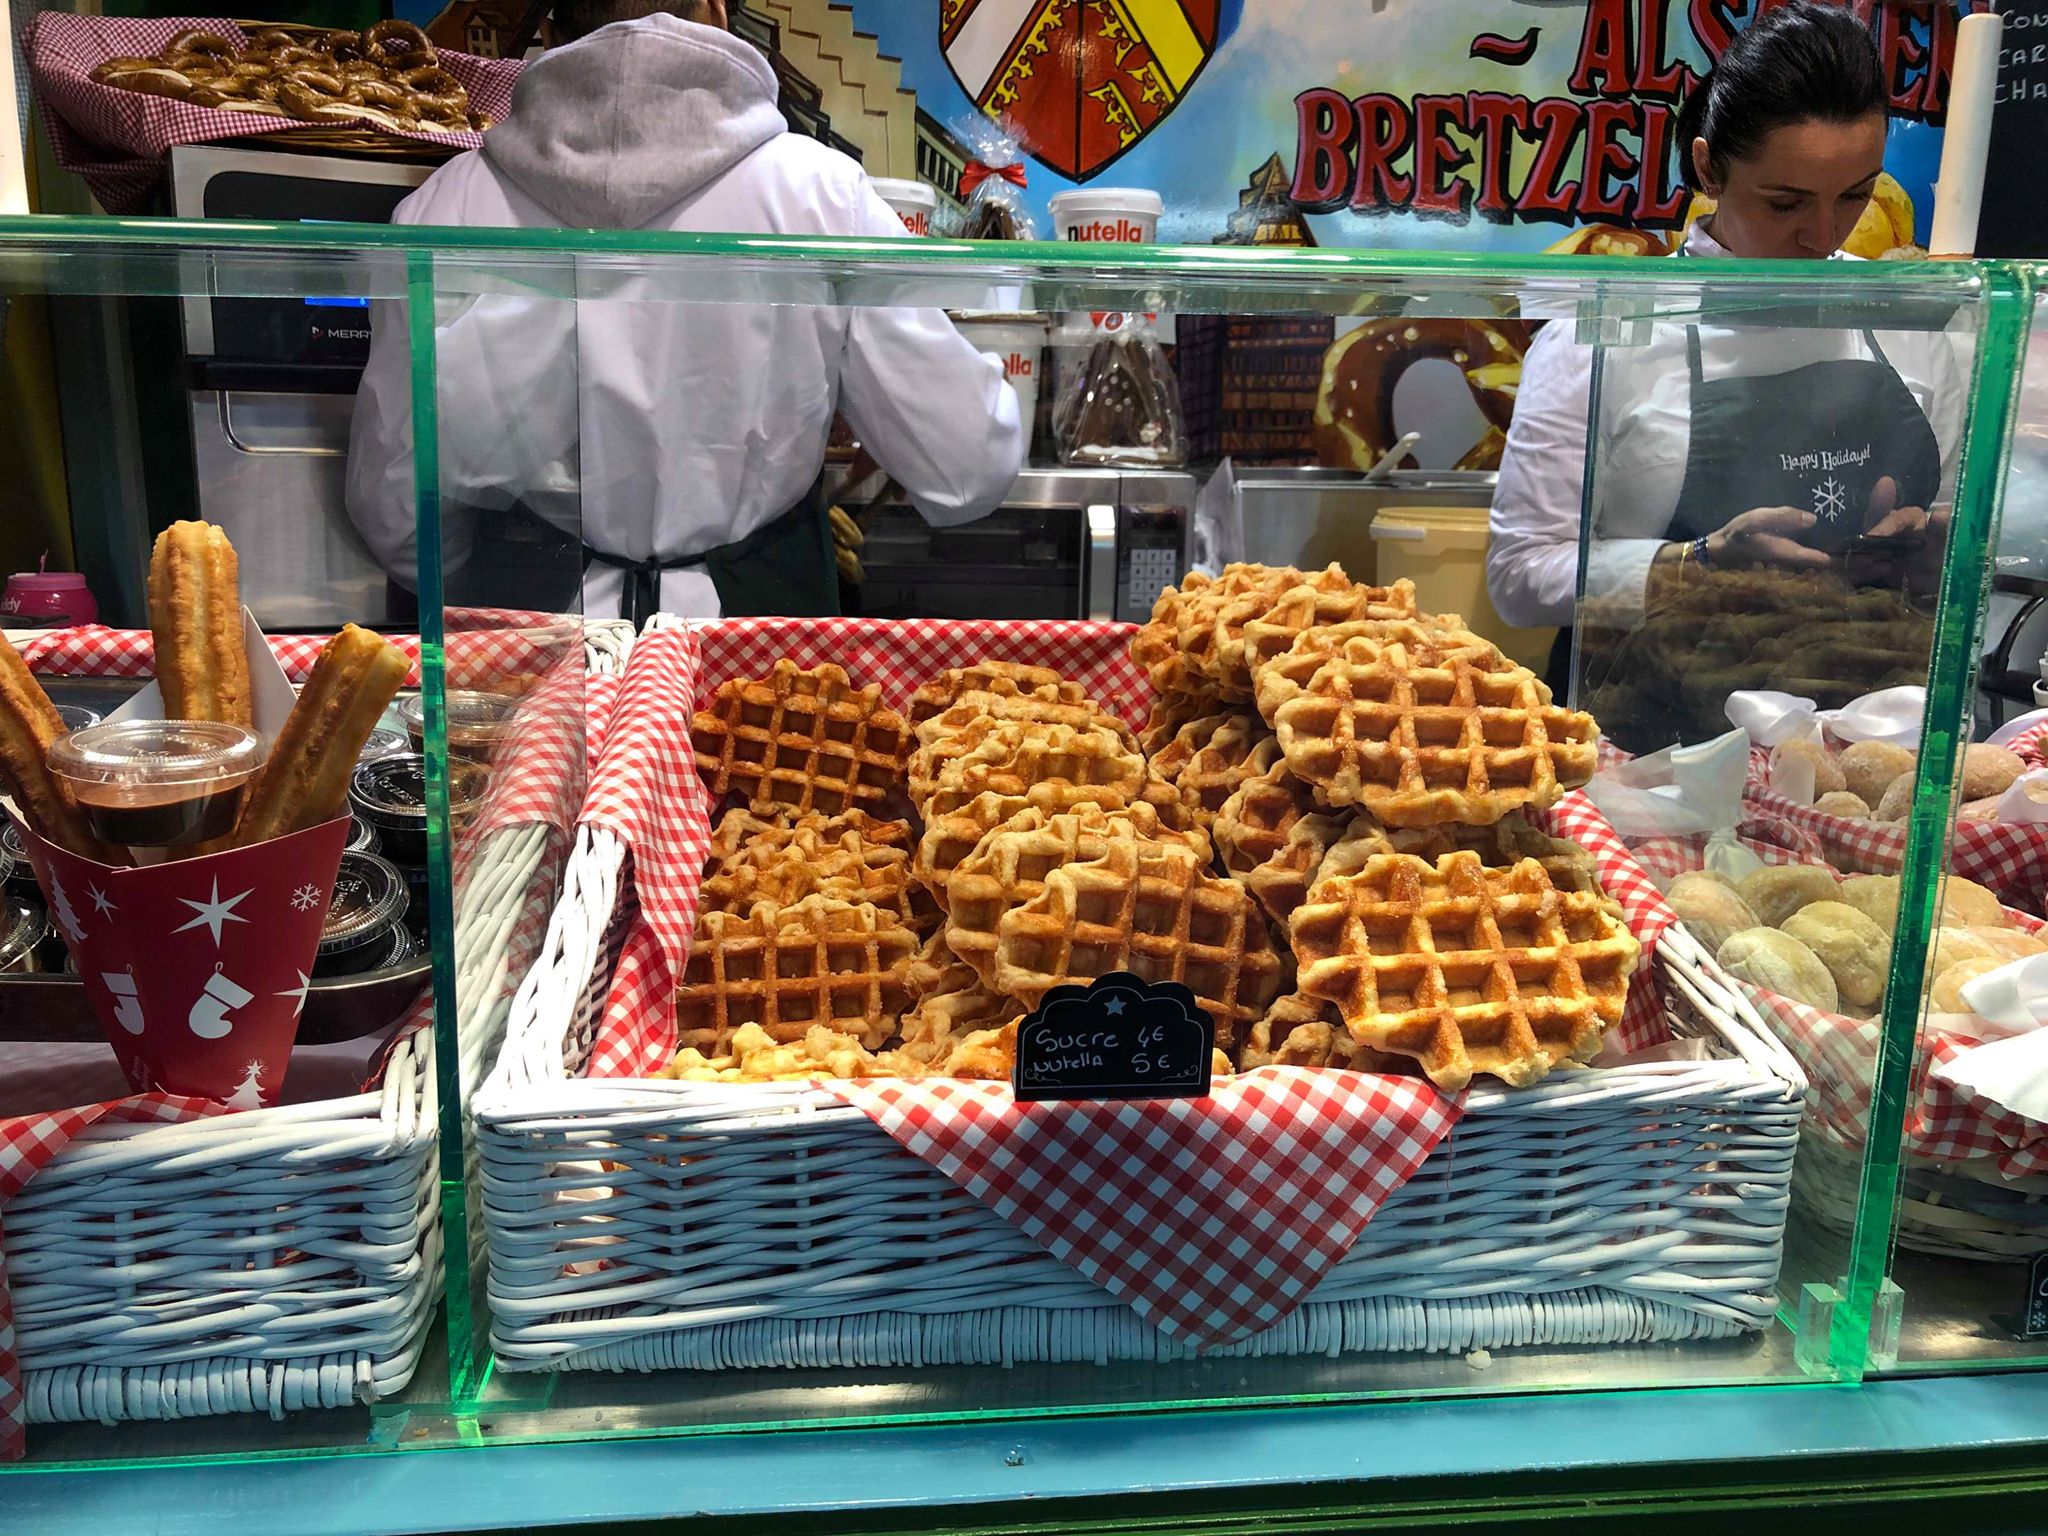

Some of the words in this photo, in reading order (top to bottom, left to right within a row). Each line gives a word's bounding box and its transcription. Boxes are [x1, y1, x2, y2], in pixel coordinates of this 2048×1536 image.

[1289, 87, 1691, 229] BRETZEL
[1067, 219, 1142, 242] nutella
[1780, 449, 1818, 470] Happy
[1820, 443, 1870, 470] Holidays!
[1036, 1029, 1119, 1052] Sucre
